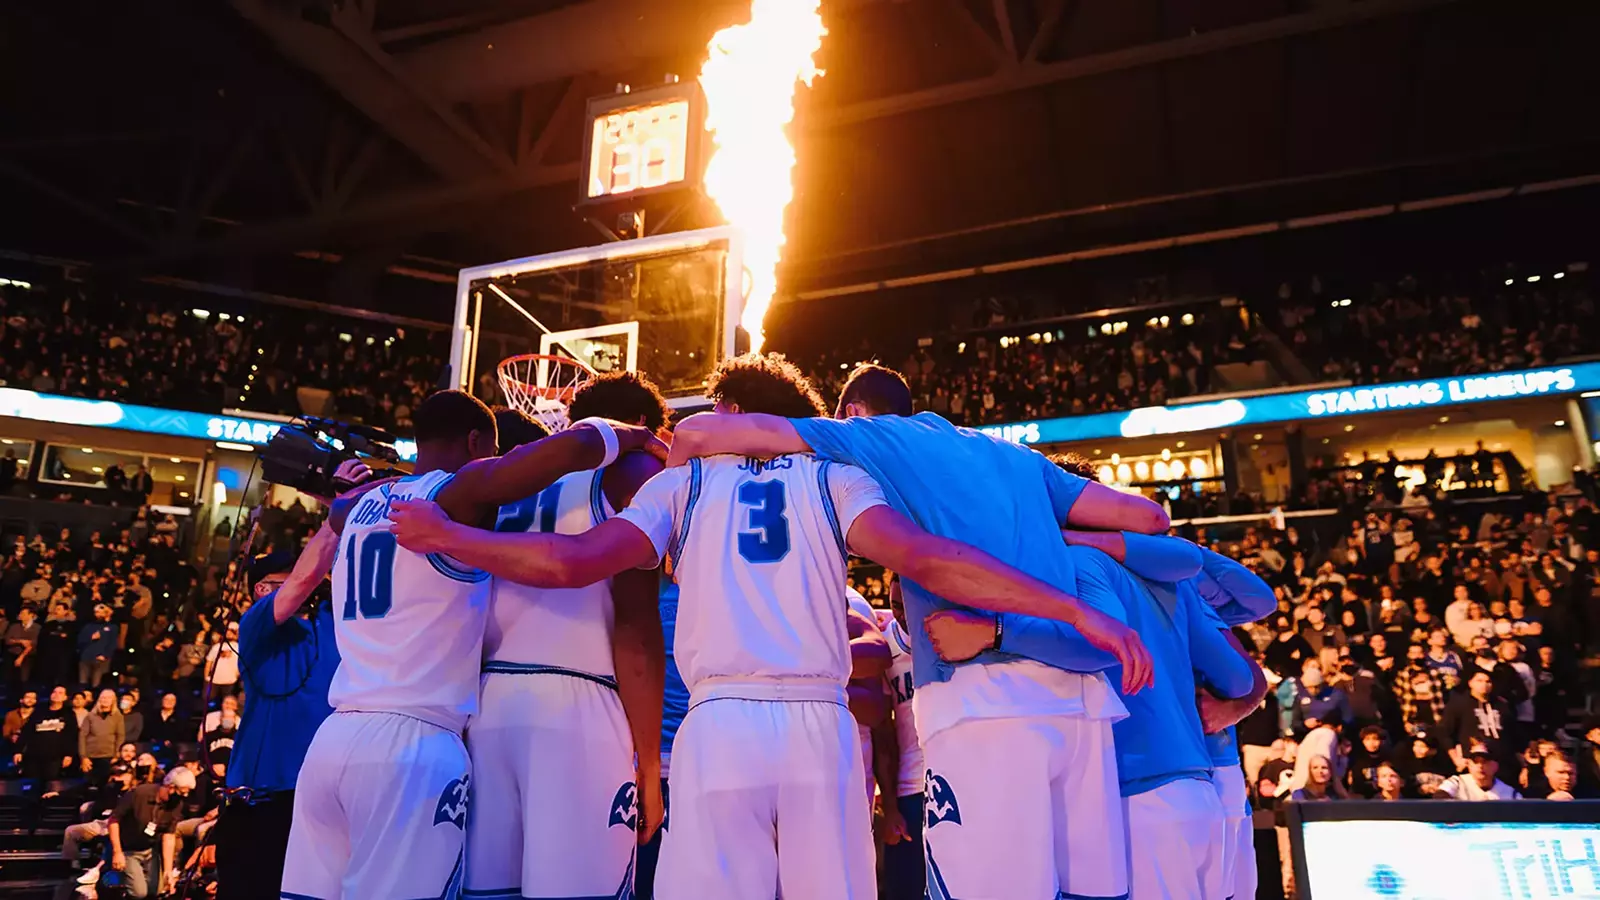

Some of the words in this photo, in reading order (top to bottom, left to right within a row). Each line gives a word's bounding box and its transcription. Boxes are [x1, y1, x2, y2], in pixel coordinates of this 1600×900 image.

[611, 137, 670, 194] 30
[1306, 382, 1443, 415] STARTING
[1450, 369, 1575, 401] LINEUPS
[738, 478, 791, 564] 3
[342, 530, 398, 620] 10
